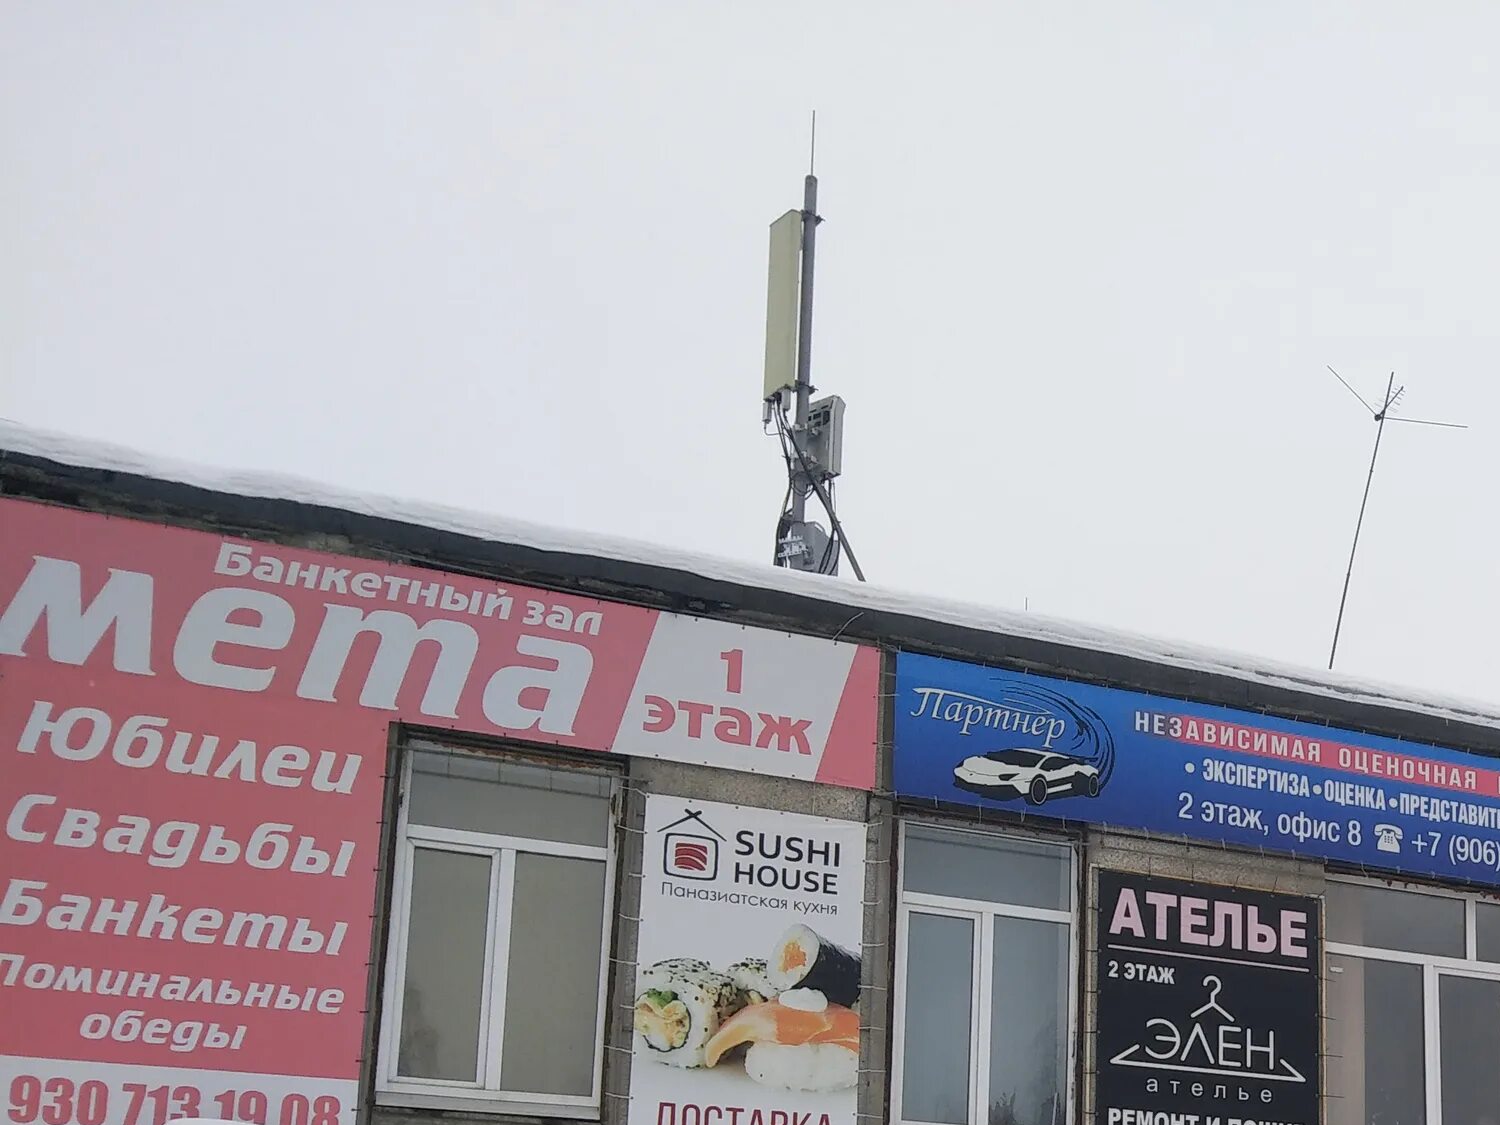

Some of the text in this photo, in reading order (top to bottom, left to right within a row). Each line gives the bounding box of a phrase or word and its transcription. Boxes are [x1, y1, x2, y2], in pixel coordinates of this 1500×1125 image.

[214, 541, 603, 636] Банкетный зал
[720, 648, 743, 694] 1
[17, 700, 362, 794] Юбилеи
[643, 695, 813, 755] этаж
[909, 687, 1066, 748] Партнер
[1135, 711, 1321, 763] НЕЗАВИСИМАЯ
[1338, 747, 1477, 790] ОЦЕНОЧНАЯ
[1202, 757, 1310, 798] ЭКСПЕРТИЗА
[1324, 779, 1387, 811] ОЦЕНКА
[6, 795, 355, 877] Свадьбы
[735, 829, 841, 868] SUSHI
[1178, 791, 1194, 820] 2
[1201, 802, 1269, 836] этаж,
[1277, 810, 1340, 843] офис
[1347, 820, 1362, 846] 8
[1411, 831, 1442, 857] +7
[661, 881, 838, 916] Паназиатская кухня
[734, 861, 838, 896] HOUSE
[0, 878, 348, 956] Банкеты
[1109, 887, 1308, 959] АТЕЛЬЕ
[0, 953, 345, 1013] Поминальные
[1108, 960, 1175, 985] 2 ЭТАЖ
[80, 1010, 247, 1052] обеды
[1144, 1018, 1275, 1071] ЭЛЕН
[1146, 1077, 1273, 1103] ателье
